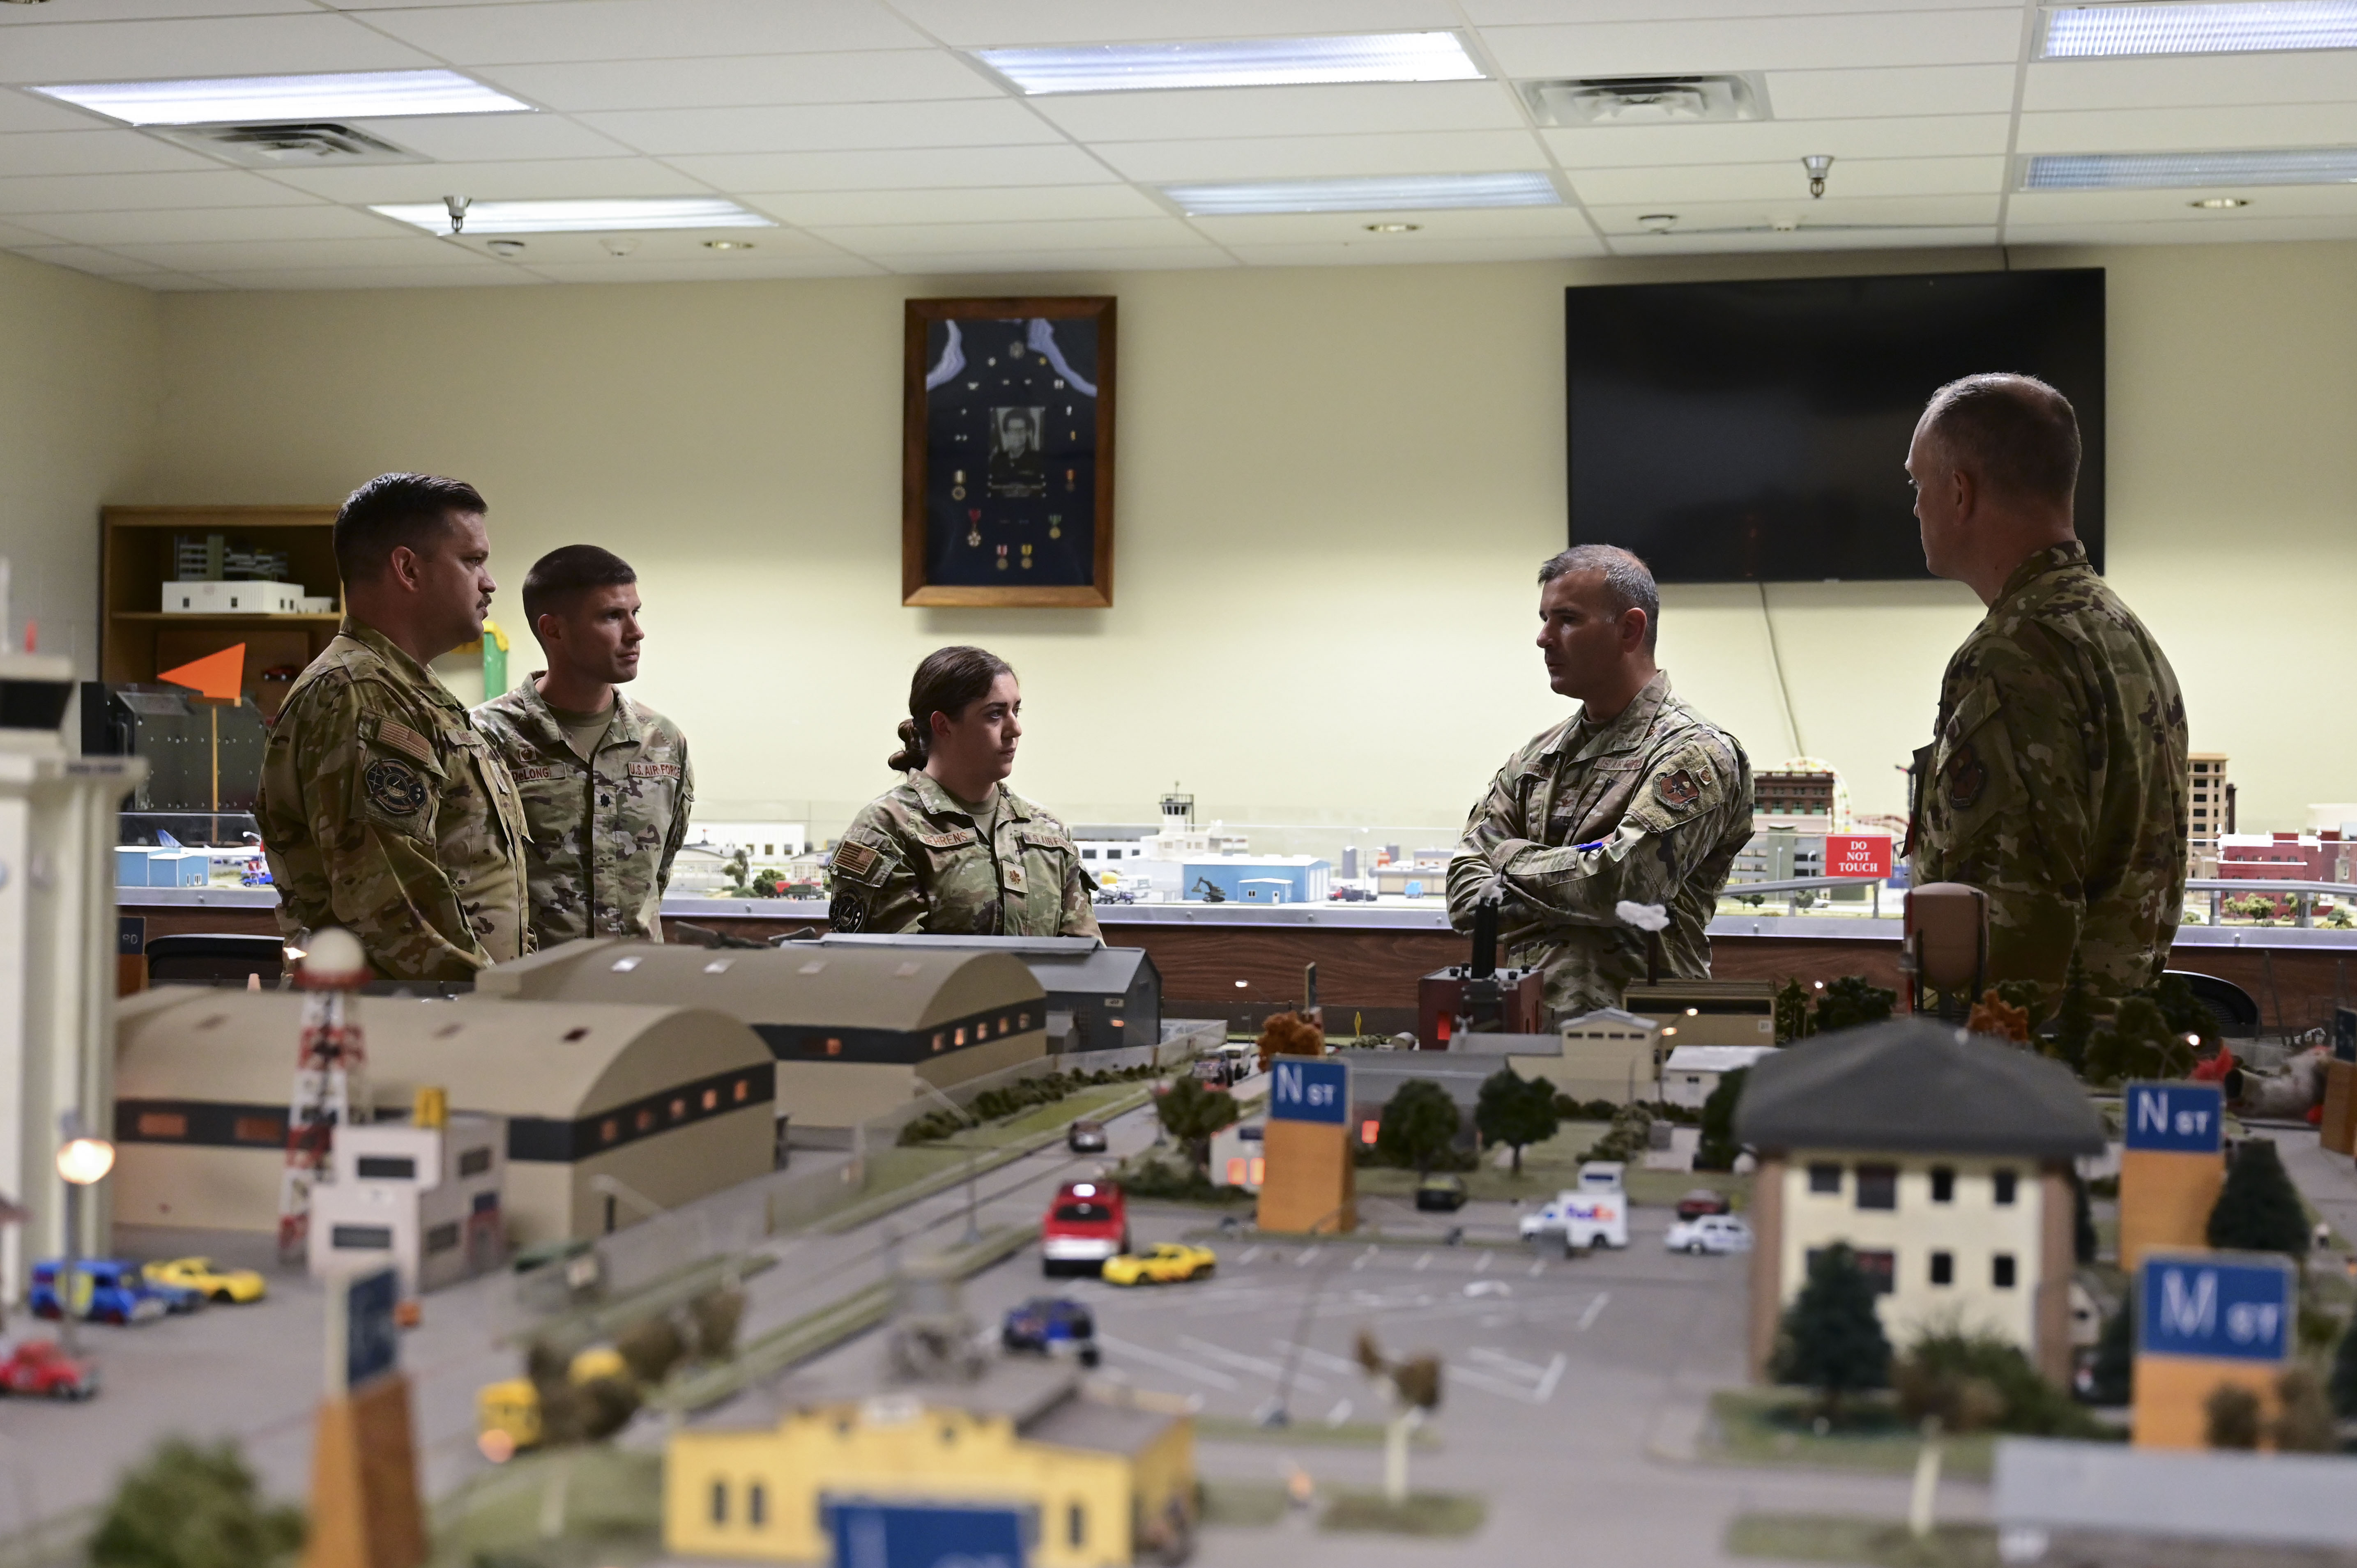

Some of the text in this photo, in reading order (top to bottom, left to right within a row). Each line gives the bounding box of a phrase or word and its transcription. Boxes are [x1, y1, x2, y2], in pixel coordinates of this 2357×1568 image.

[511, 767, 550, 782] DeLONG
[629, 764, 680, 778] U.S. AIR FORCE
[922, 832, 968, 846] BEHRENS
[1041, 836, 1053, 846] AIR
[1851, 841, 1867, 850] DO
[1846, 851, 1871, 861] NOT
[1838, 862, 1878, 872] TOUCH
[1277, 1062, 1336, 1107] N ST
[2138, 1090, 2211, 1136] N ST
[2159, 1268, 2219, 1338] M
